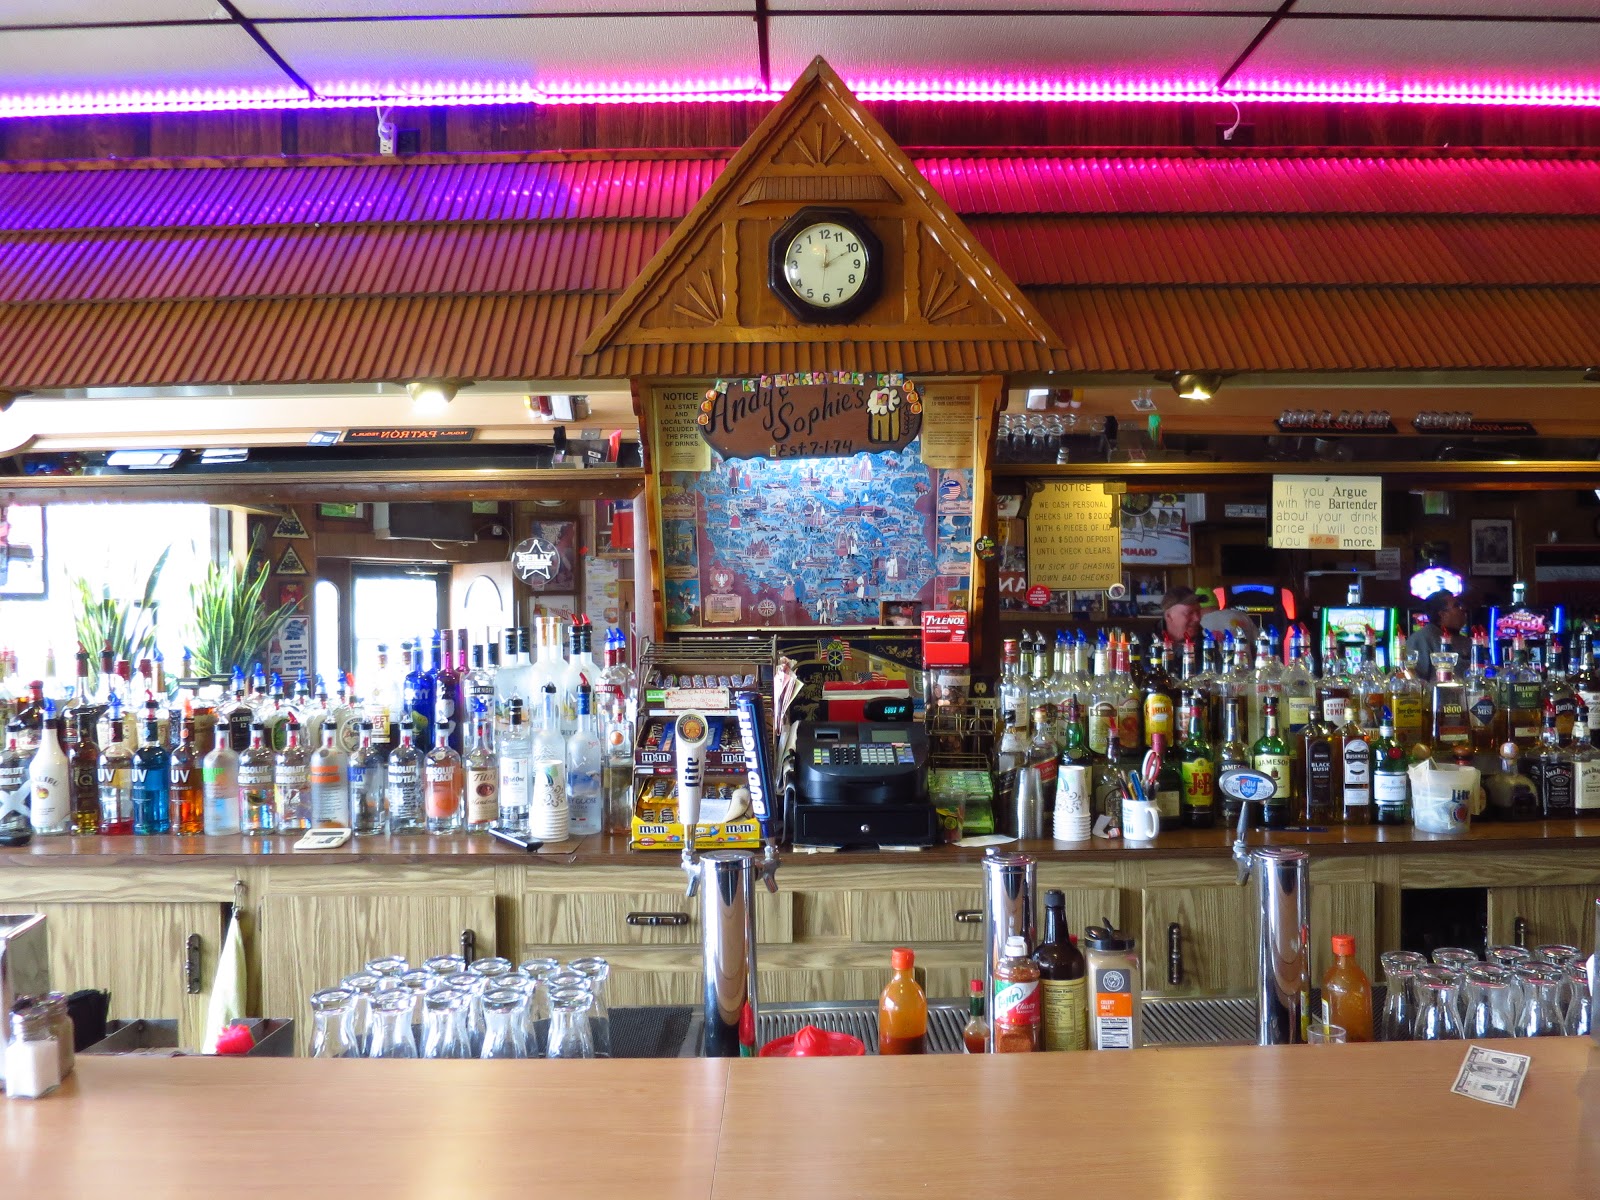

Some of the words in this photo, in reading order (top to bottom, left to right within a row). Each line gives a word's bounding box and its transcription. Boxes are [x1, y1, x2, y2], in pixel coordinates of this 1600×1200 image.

[819, 229, 831, 239] 12
[833, 232, 843, 242] 11
[807, 235, 812, 244] 1
[795, 244, 802, 253] 2
[846, 243, 858, 253] 10
[791, 260, 798, 270] 3
[853, 259, 860, 269] 9
[796, 279, 803, 288] 4
[848, 274, 856, 284] 8
[806, 289, 814, 298] 5
[837, 288, 844, 297] 7
[823, 293, 830, 303] 6
[663, 392, 698, 400] NOTICE
[704, 384, 773, 434] Andy
[772, 388, 864, 442] Sophie's
[812, 440, 852, 455] 7-1-74
[1286, 485, 1293, 496] If
[1303, 488, 1324, 498] you
[1333, 486, 1367, 498] Argue
[1276, 499, 1297, 508] with
[1304, 499, 1320, 509] the
[1329, 498, 1377, 510] Bartender
[1276, 511, 1308, 521] about
[1318, 512, 1342, 523] your
[1350, 512, 1378, 522] drink
[1276, 524, 1304, 534] price
[1327, 524, 1345, 534] will
[1353, 525, 1378, 534] cost
[1279, 537, 1300, 547] you
[1343, 538, 1375, 547] more.
[926, 615, 965, 626] TYLENOL
[1443, 705, 1462, 714] 1800
[737, 711, 758, 769] LIGHT
[239, 765, 268, 774] ABSOLUT
[426, 766, 455, 774] ABSOLUT
[685, 757, 700, 787] Lite
[97, 769, 114, 782] UV
[131, 769, 147, 783] UV
[171, 770, 190, 783] UV
[427, 774, 453, 782] APEACH
[474, 772, 496, 782] Tito's
[1188, 773, 1212, 796] J&B
[748, 771, 766, 815] BUD
